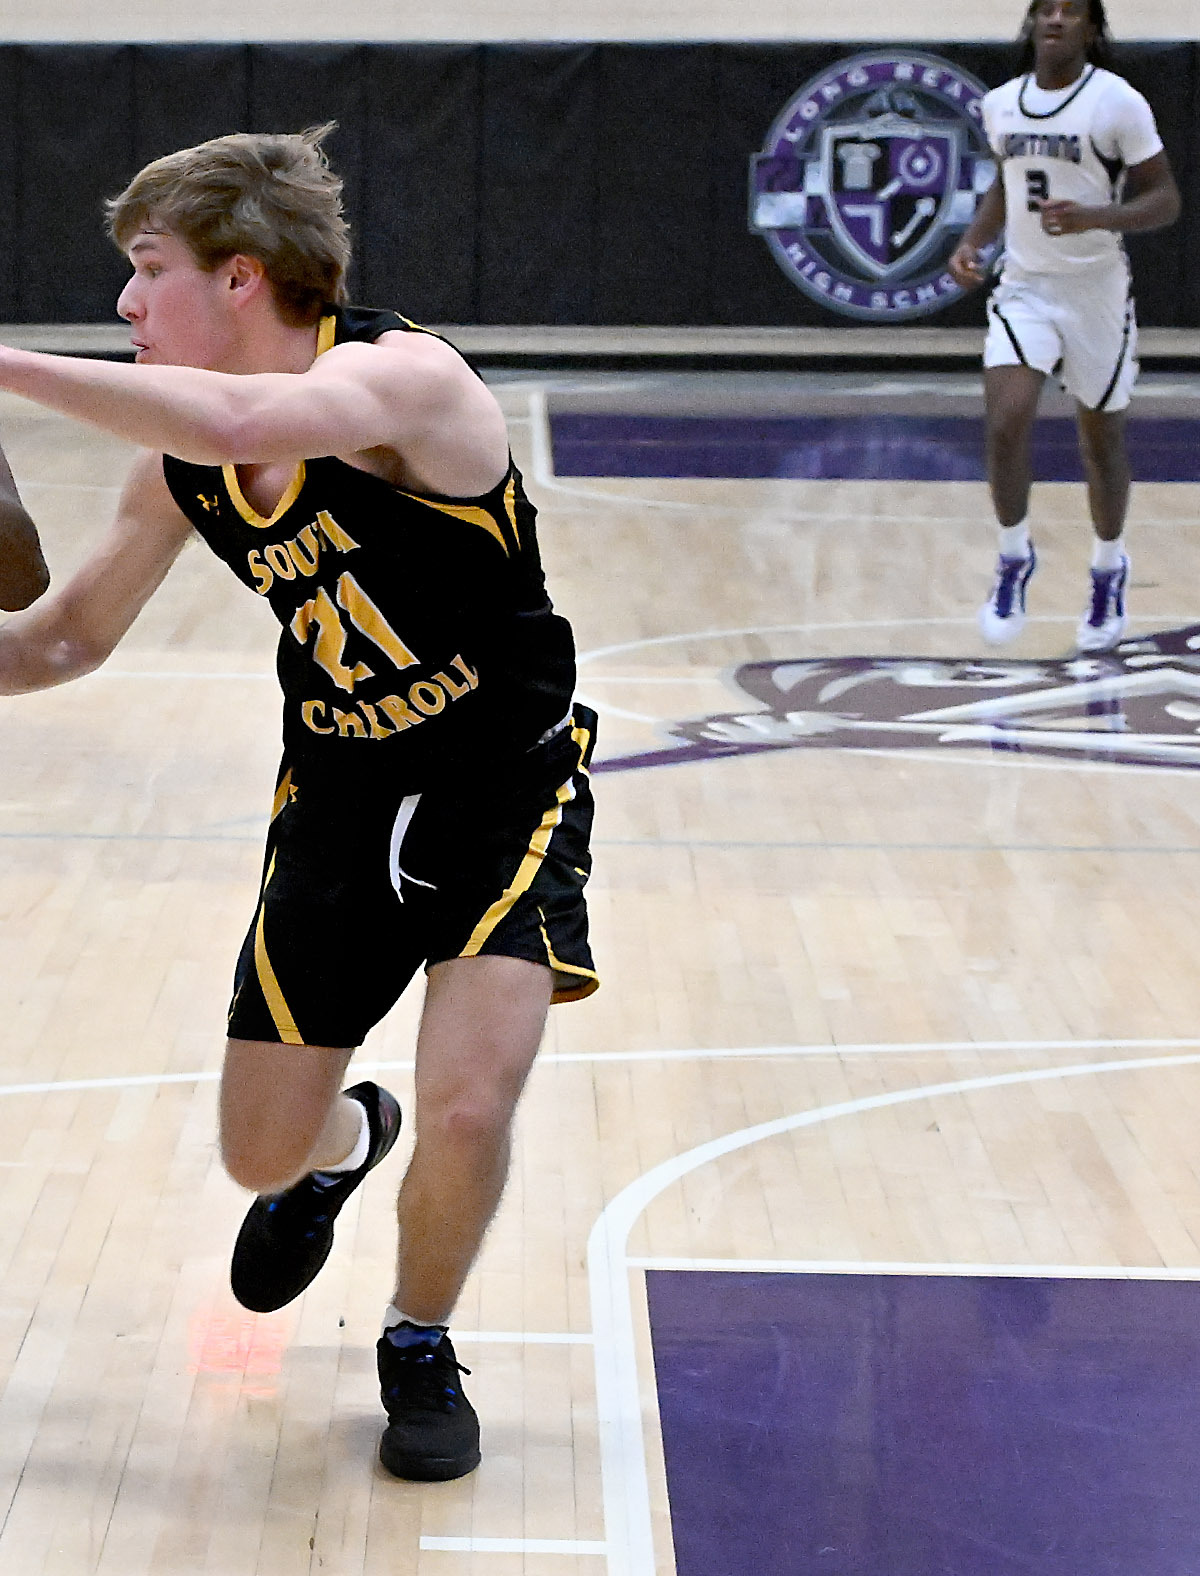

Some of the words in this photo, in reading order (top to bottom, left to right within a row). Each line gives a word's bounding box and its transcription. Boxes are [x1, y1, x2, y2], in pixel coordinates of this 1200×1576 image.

[785, 67, 869, 142] LONG
[894, 63, 984, 119] REAC
[786, 243, 853, 303] HIGH
[289, 571, 422, 694] 21
